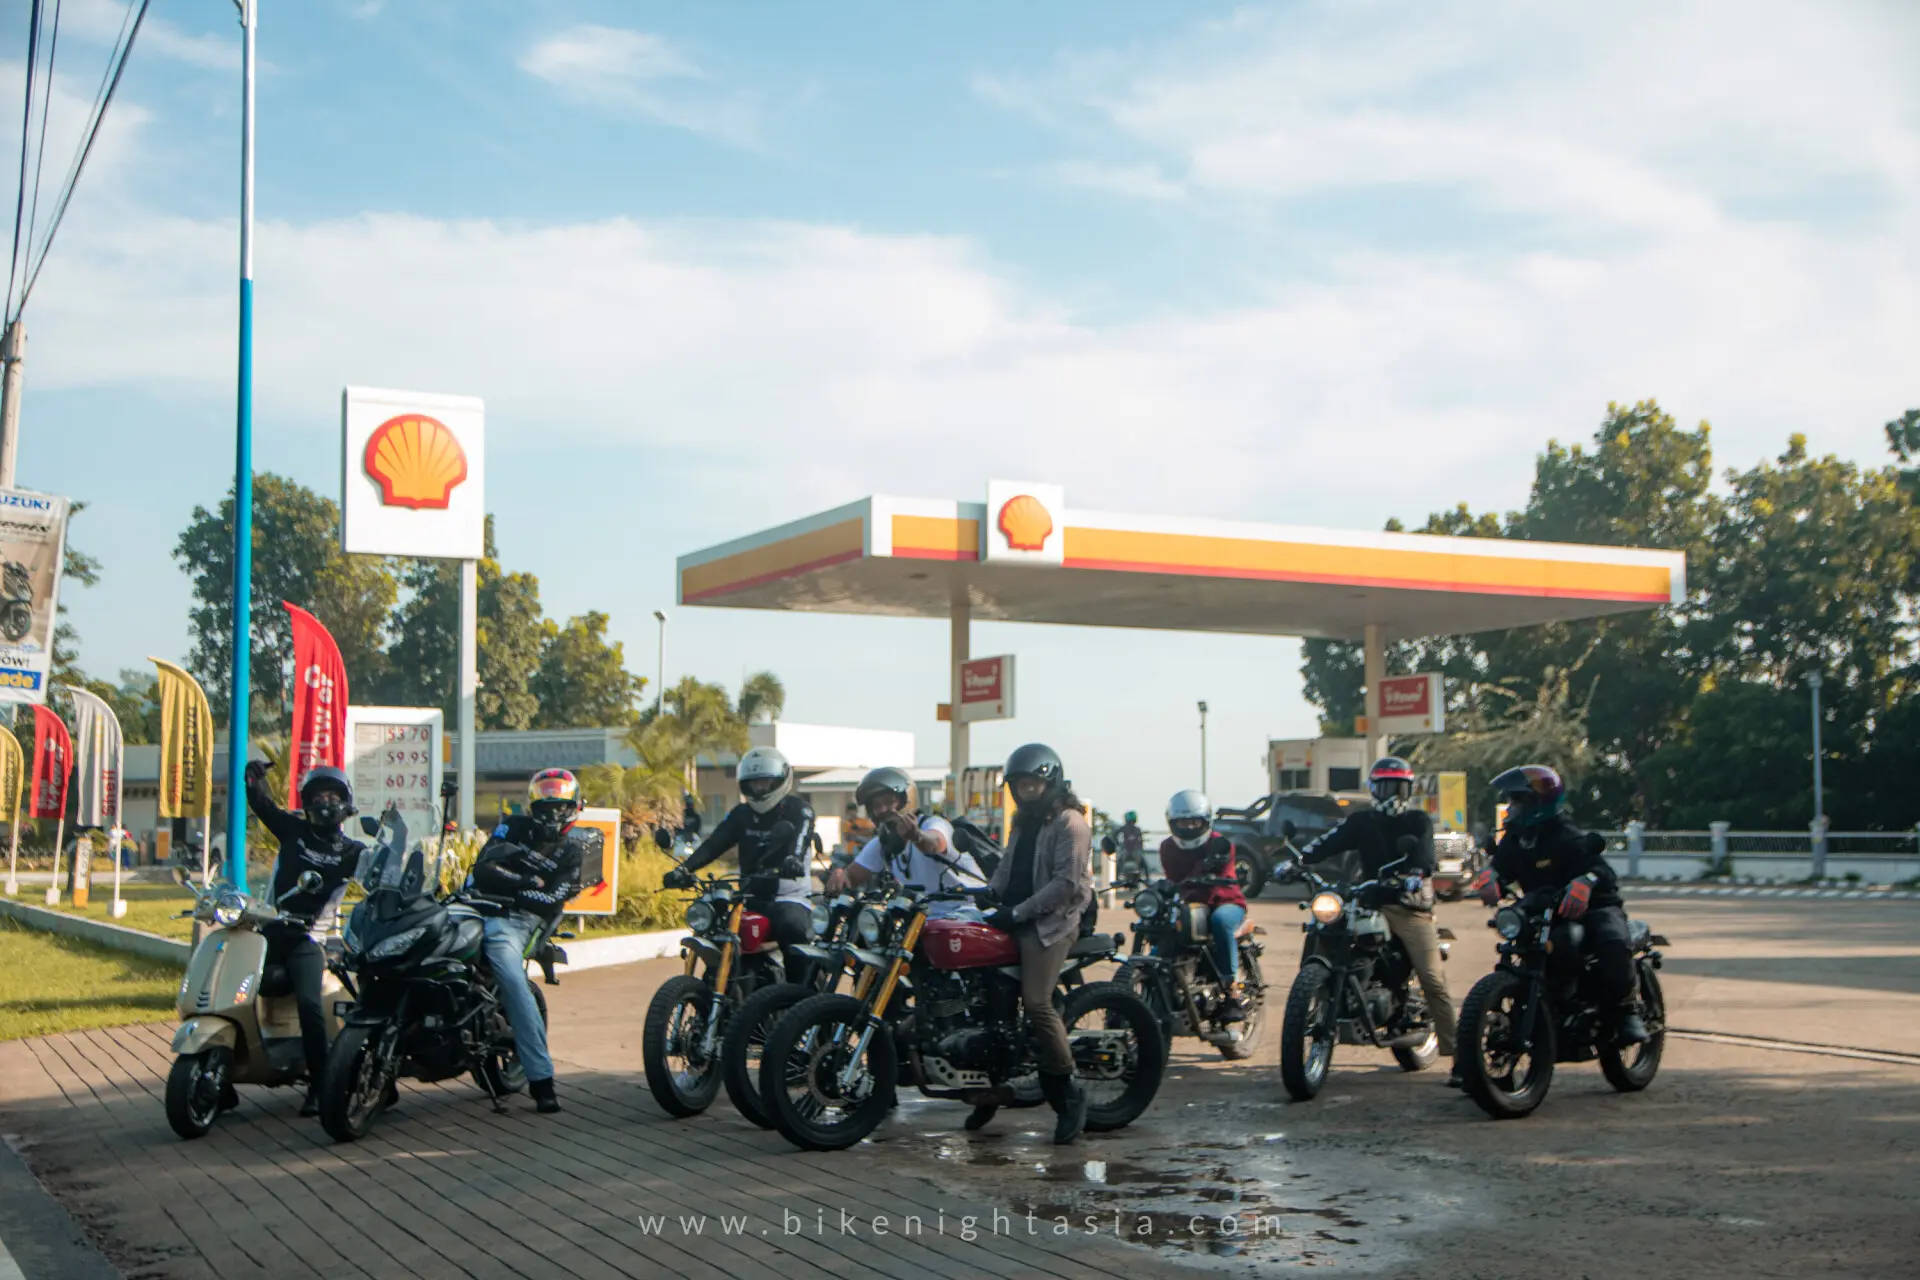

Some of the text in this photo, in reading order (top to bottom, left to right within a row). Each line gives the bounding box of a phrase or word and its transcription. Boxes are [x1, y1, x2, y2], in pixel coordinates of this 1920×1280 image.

[0, 655, 30, 668] OW!
[182, 706, 197, 804] FuelSave
[311, 672, 333, 768] Power
[102, 769, 116, 816] Shell
